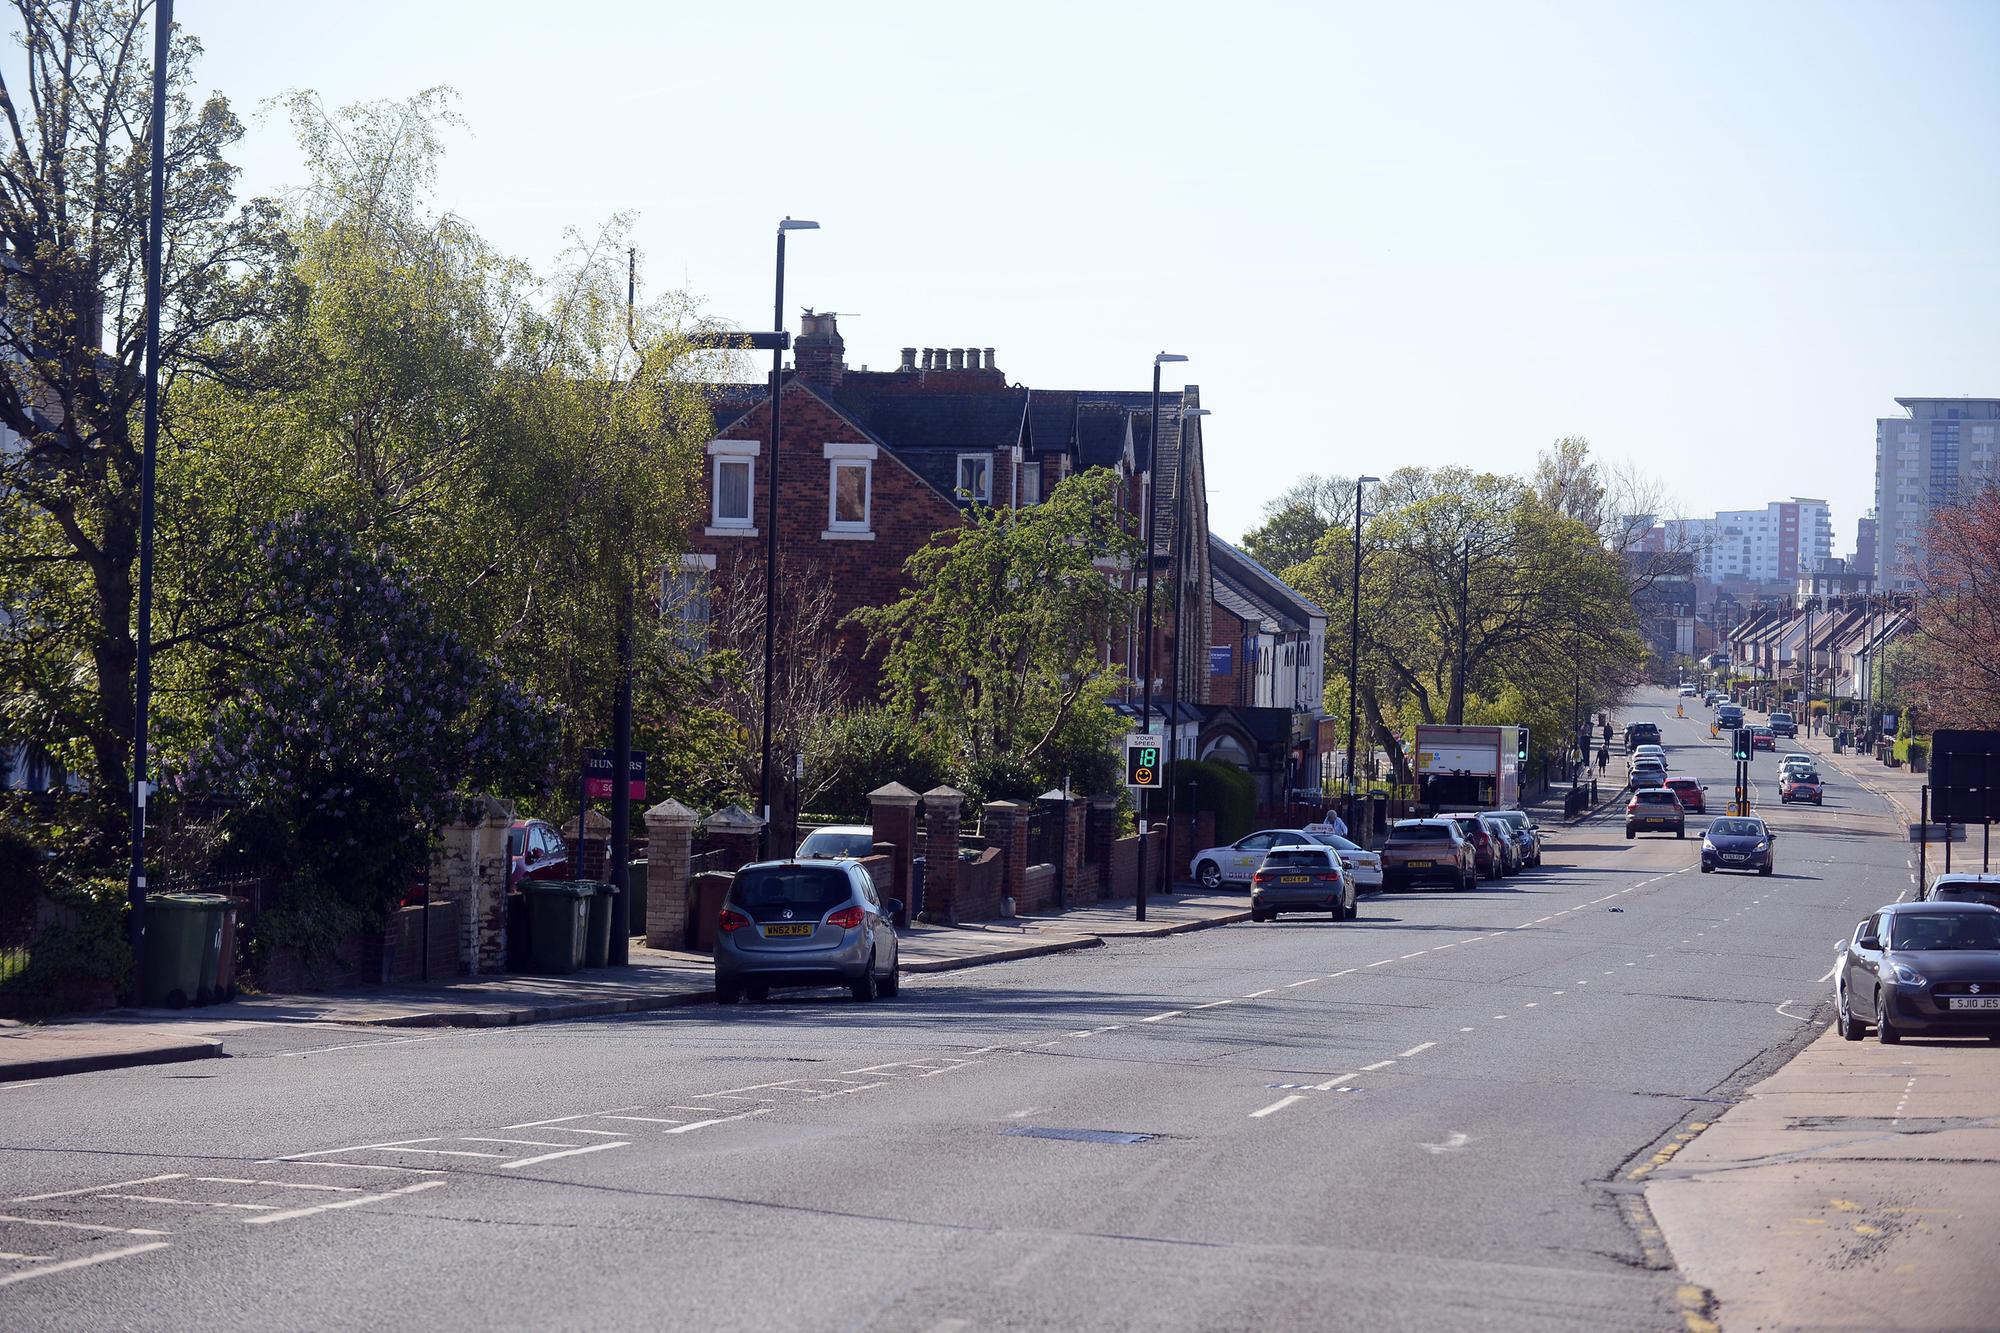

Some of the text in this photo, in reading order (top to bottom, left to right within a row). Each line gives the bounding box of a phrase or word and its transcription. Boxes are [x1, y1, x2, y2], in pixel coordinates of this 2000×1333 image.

[1140, 748, 1156, 767] 18
[590, 759, 642, 770] HUNRS
[767, 925, 809, 934] WN62 WFS
[1957, 999, 1999, 1008] SJ10 JES
